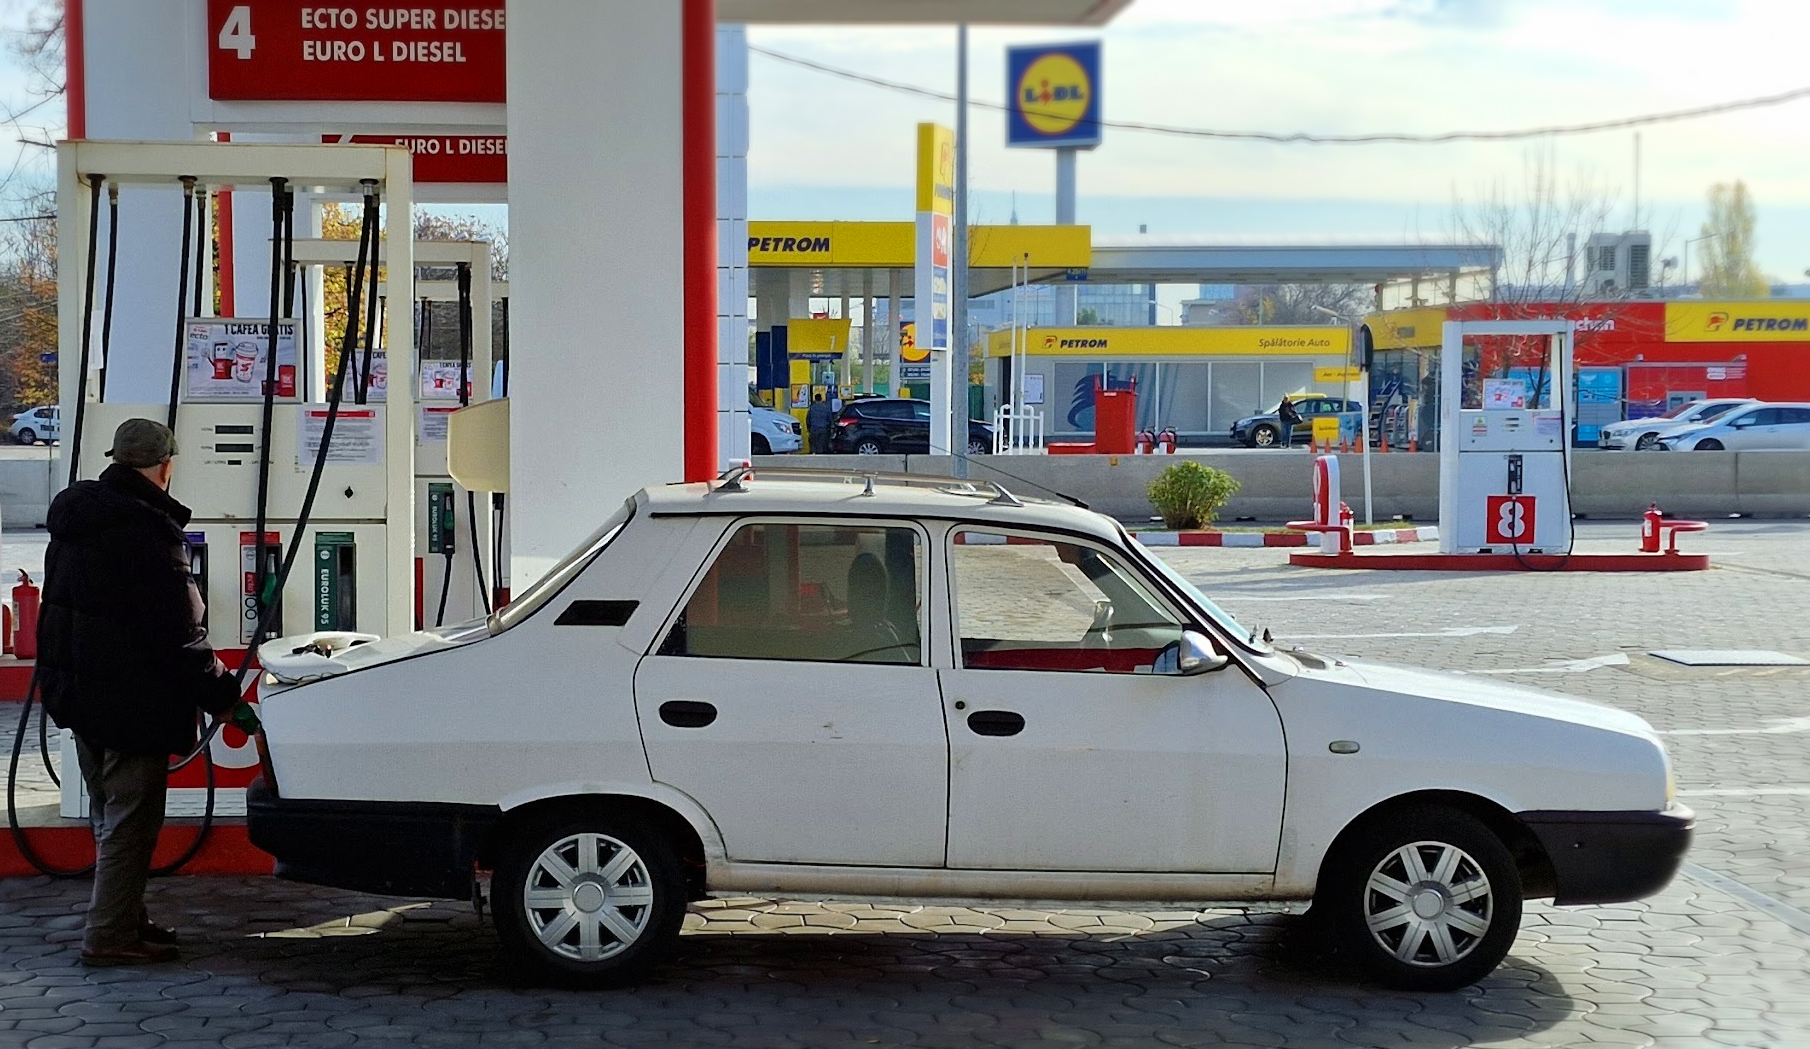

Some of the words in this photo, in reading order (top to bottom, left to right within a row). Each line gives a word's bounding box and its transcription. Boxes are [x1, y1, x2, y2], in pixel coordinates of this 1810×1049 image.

[301, 8, 358, 30] ECTO
[365, 8, 437, 31] SUPER
[444, 9, 506, 32] DIESE
[218, 5, 256, 60] 4
[302, 40, 366, 62] EURO
[373, 41, 386, 62] L
[392, 41, 467, 63] DIESEL
[445, 139, 455, 155] L
[459, 139, 507, 156] DIESE
[748, 237, 830, 252] PETROM
[231, 324, 259, 335] CAFEA
[261, 324, 294, 335] GTIS
[1732, 319, 1808, 332] PETROM
[1060, 340, 1108, 349] PETROM
[1307, 339, 1331, 347] Auto
[1497, 501, 1526, 538] 8
[320, 568, 330, 612] EUROLUK
[320, 613, 330, 625] 95
